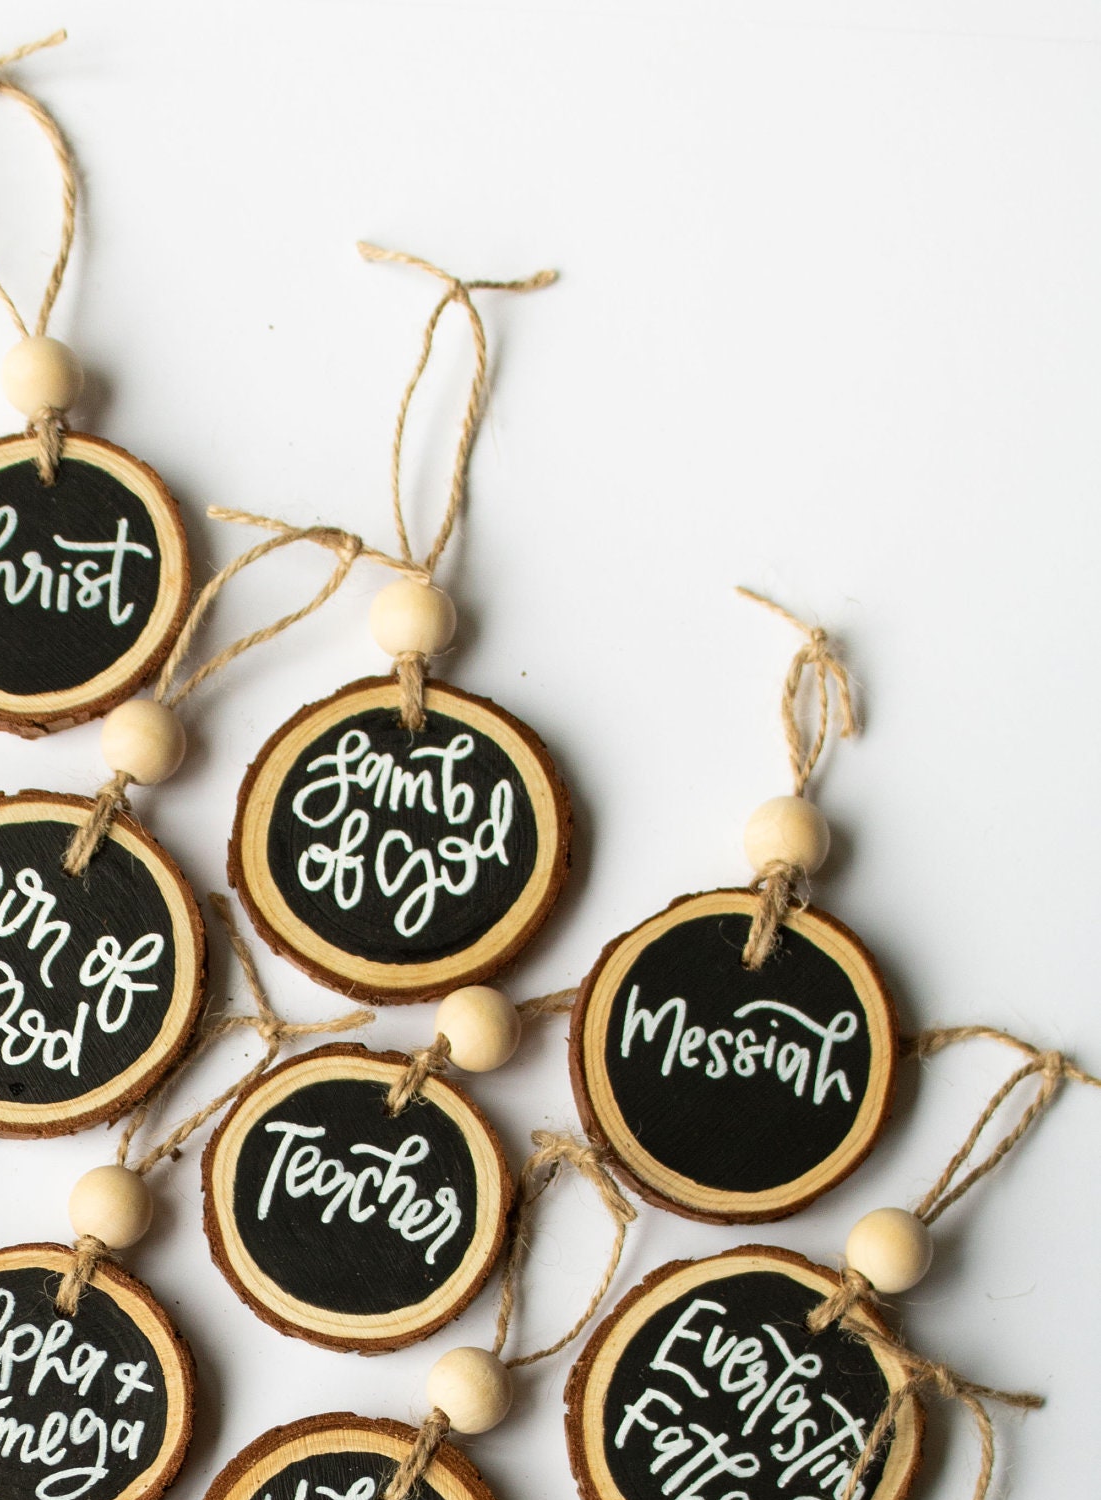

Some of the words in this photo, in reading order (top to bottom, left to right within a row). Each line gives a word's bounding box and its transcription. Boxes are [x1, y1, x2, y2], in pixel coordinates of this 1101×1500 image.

[291, 729, 475, 829] Lamb
[297, 808, 370, 910] of
[374, 778, 514, 938] God
[78, 932, 165, 1034] of
[620, 984, 858, 1105] Messiah
[257, 1120, 462, 1265] Teacher
